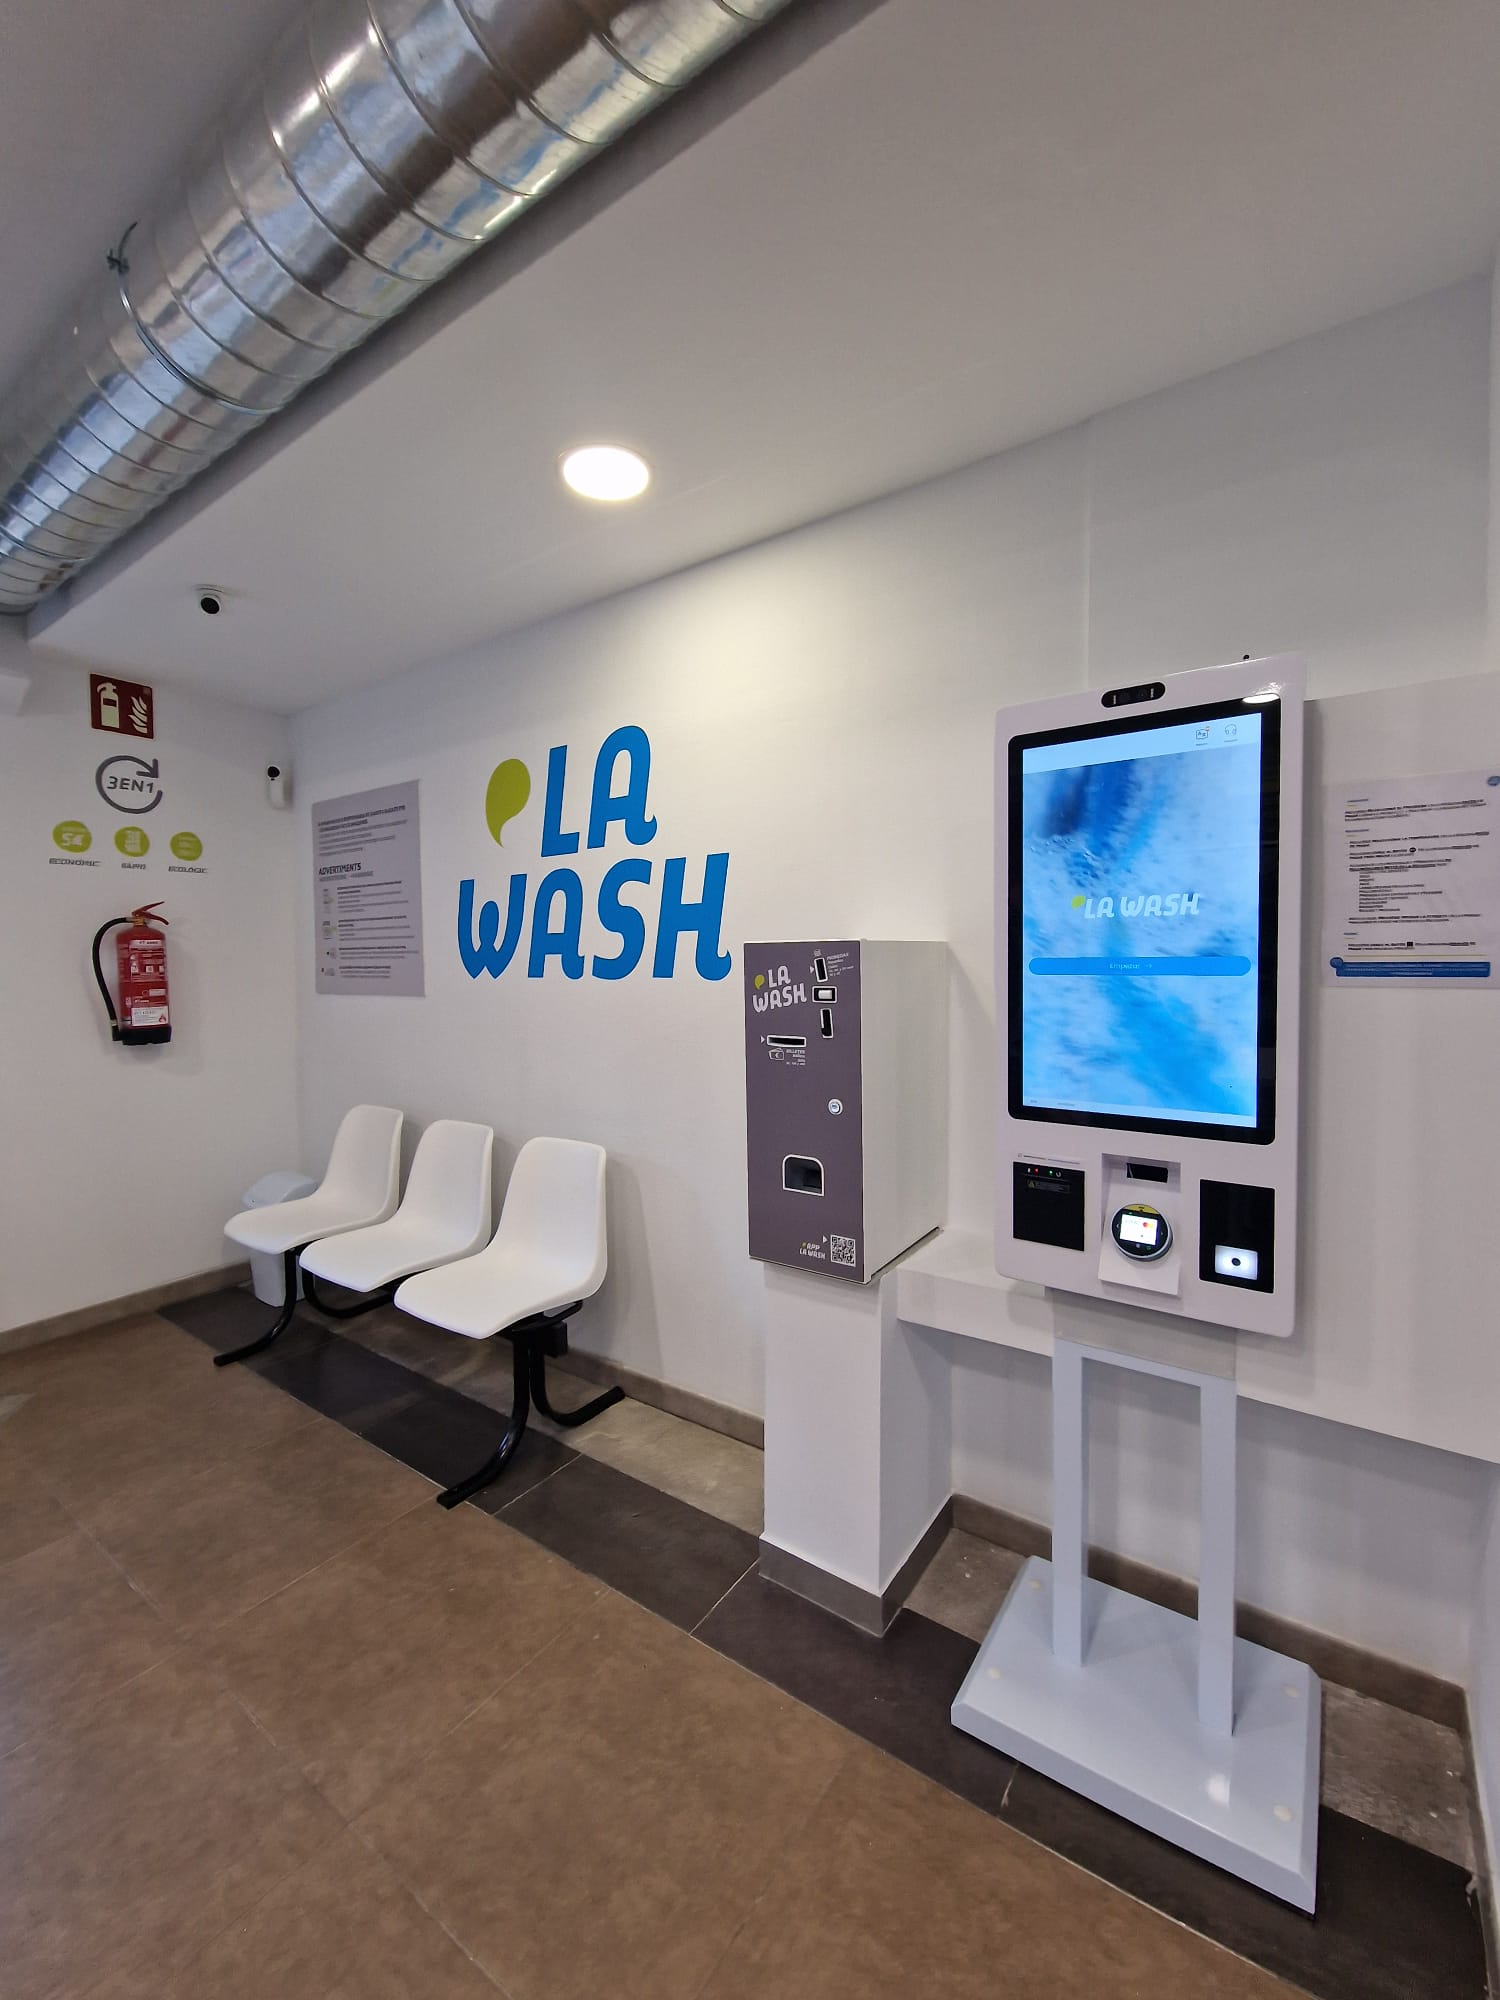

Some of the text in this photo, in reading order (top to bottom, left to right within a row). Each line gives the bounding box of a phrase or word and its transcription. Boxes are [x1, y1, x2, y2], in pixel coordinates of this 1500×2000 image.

[541, 725, 658, 857] LA
[318, 862, 362, 876] ADVERTIMENTS
[458, 853, 731, 981] WASH
[1084, 892, 1201, 919] LA WASH
[768, 965, 791, 988] LA
[753, 983, 807, 1012] WASH
[807, 1250, 826, 1259] WASH
